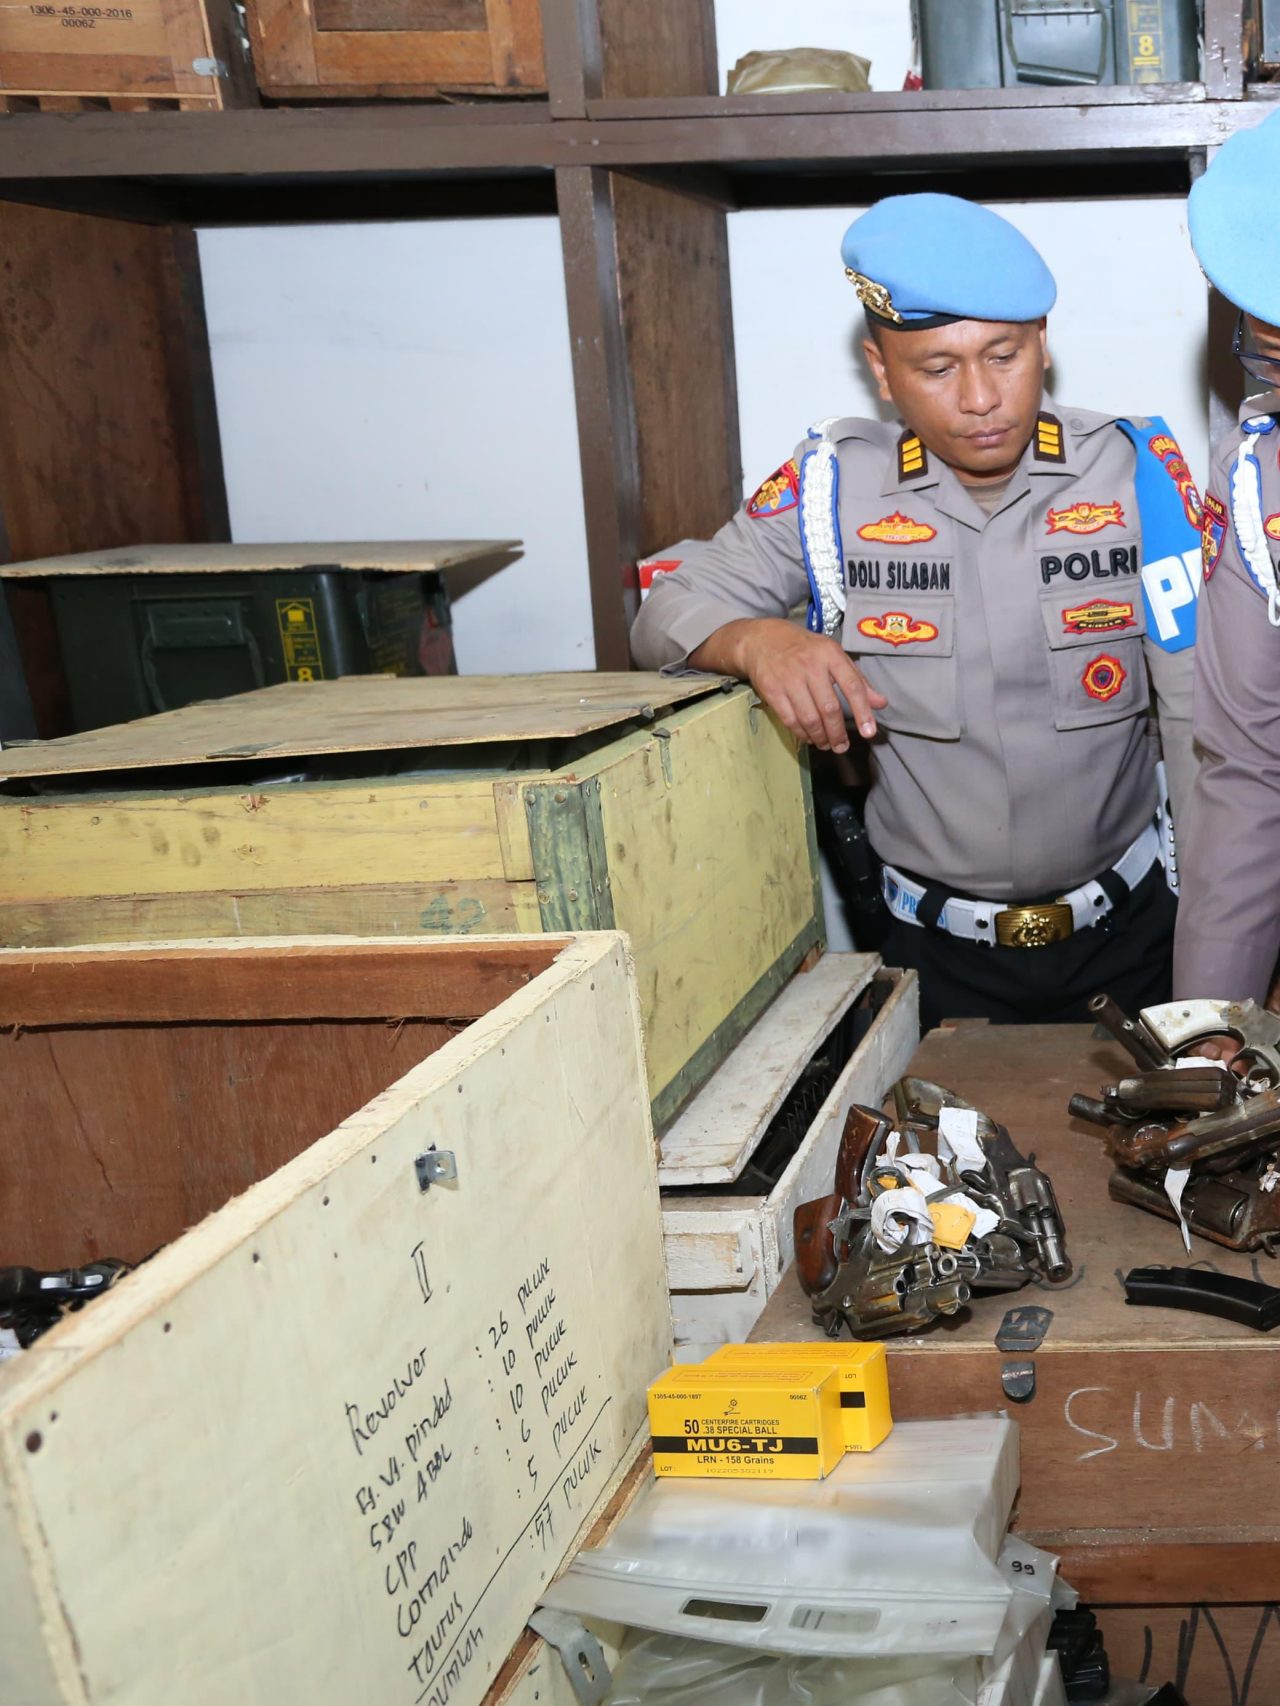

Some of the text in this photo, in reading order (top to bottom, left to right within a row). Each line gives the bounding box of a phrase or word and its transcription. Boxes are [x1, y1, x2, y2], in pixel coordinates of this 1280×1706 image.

[1139, 34, 1154, 56] 8
[848, 560, 950, 590] DOLI SILABAN
[1040, 545, 1138, 585] POLRI
[502, 1349, 516, 1376] 10
[526, 1288, 557, 1349] pucuk
[345, 1257, 551, 1456] Revolver 26 pucuk
[509, 1383, 523, 1414] 10
[534, 1319, 567, 1378] pucuk
[521, 1418, 531, 1443] 6
[541, 1351, 577, 1416] pucuk
[552, 1385, 588, 1458] pucuk
[684, 1419, 700, 1435] 50
[716, 1426, 753, 1435] SPECIAL
[755, 1427, 777, 1436] BALL
[687, 1438, 783, 1453] MU6-TJ
[697, 1456, 717, 1464] LRN
[725, 1456, 741, 1464] 158
[743, 1456, 775, 1465] Grains
[562, 1438, 602, 1510] pucuk
